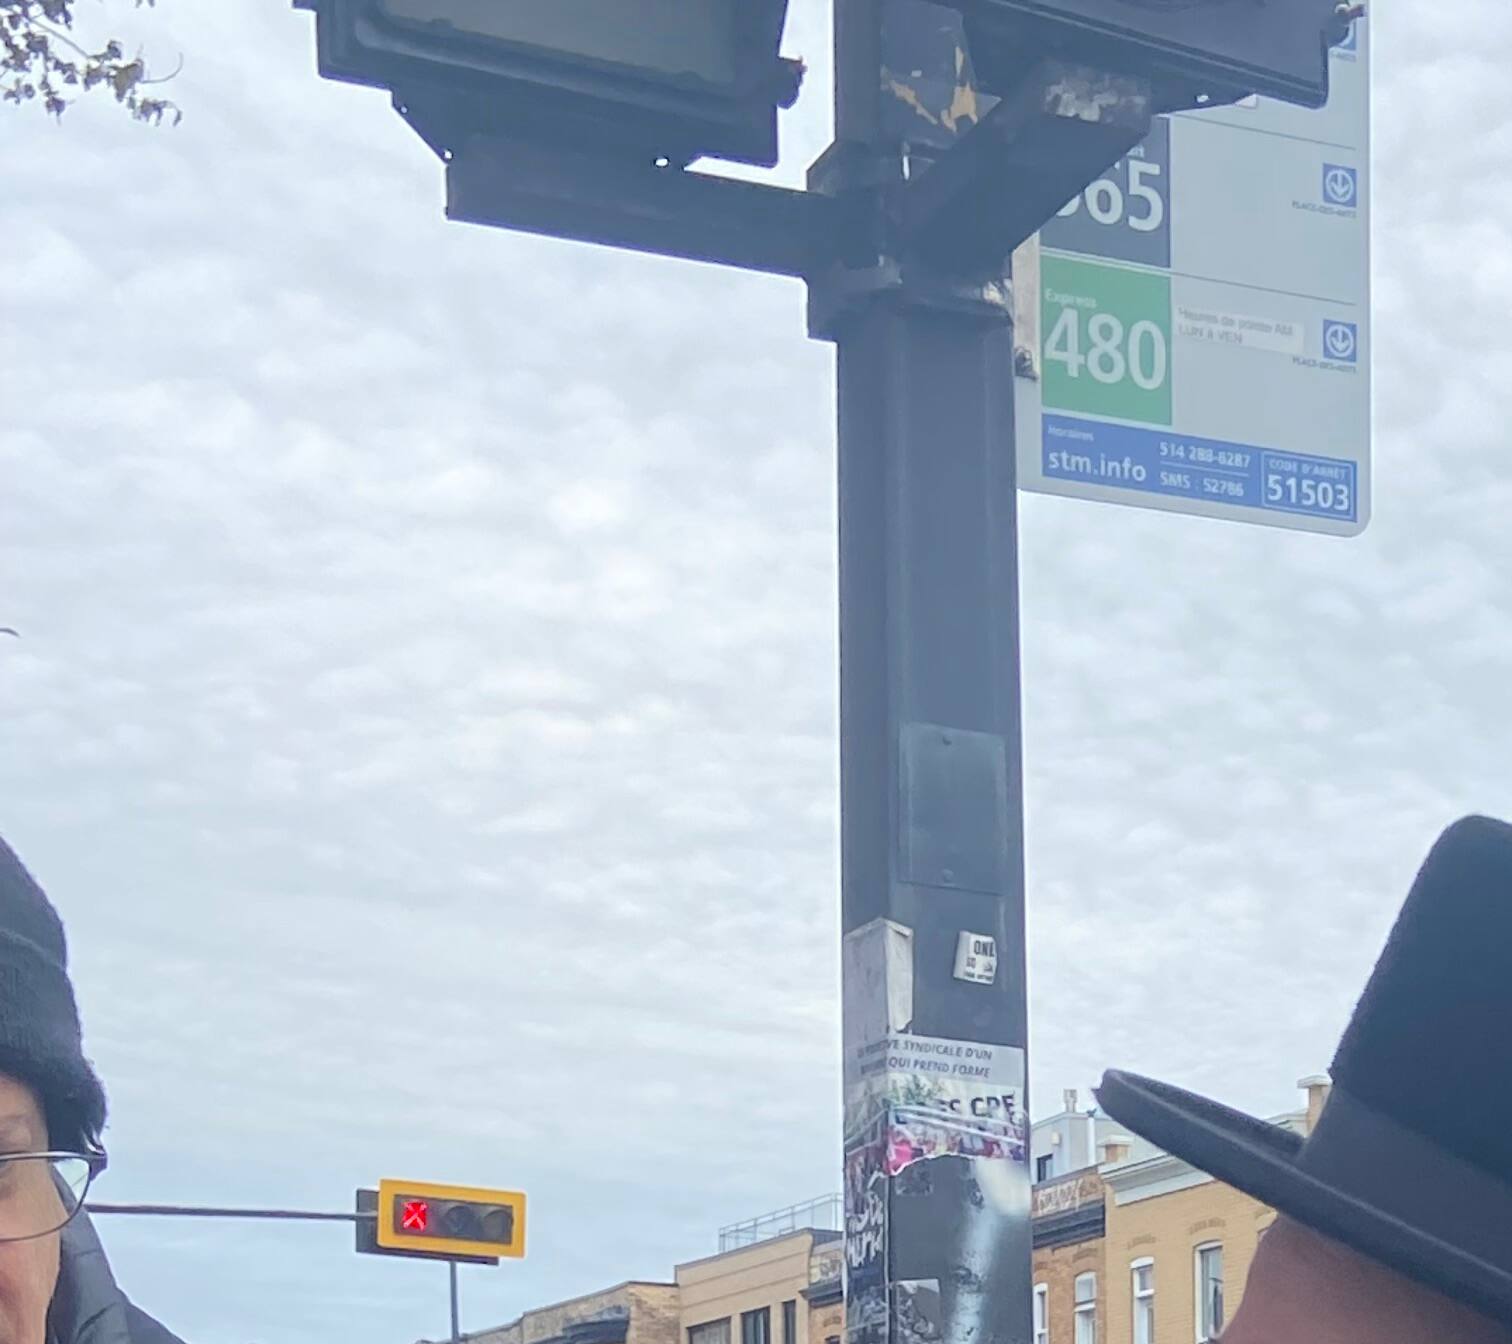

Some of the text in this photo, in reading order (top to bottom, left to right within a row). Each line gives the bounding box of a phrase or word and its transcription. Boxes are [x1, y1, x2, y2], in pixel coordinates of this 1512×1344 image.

[1056, 160, 1163, 232] 65
[1044, 307, 1167, 390] 480
[1159, 441, 1185, 459] 514
[1048, 450, 1147, 482] stm.info
[1159, 472, 1191, 489] SMS
[1267, 474, 1349, 511] 51503
[903, 1040, 962, 1058] SYNDICALE
[964, 1047, 993, 1060] D'UN
[888, 1056, 910, 1069] QUI
[912, 1059, 950, 1074] PREND
[952, 1063, 991, 1078] FORME
